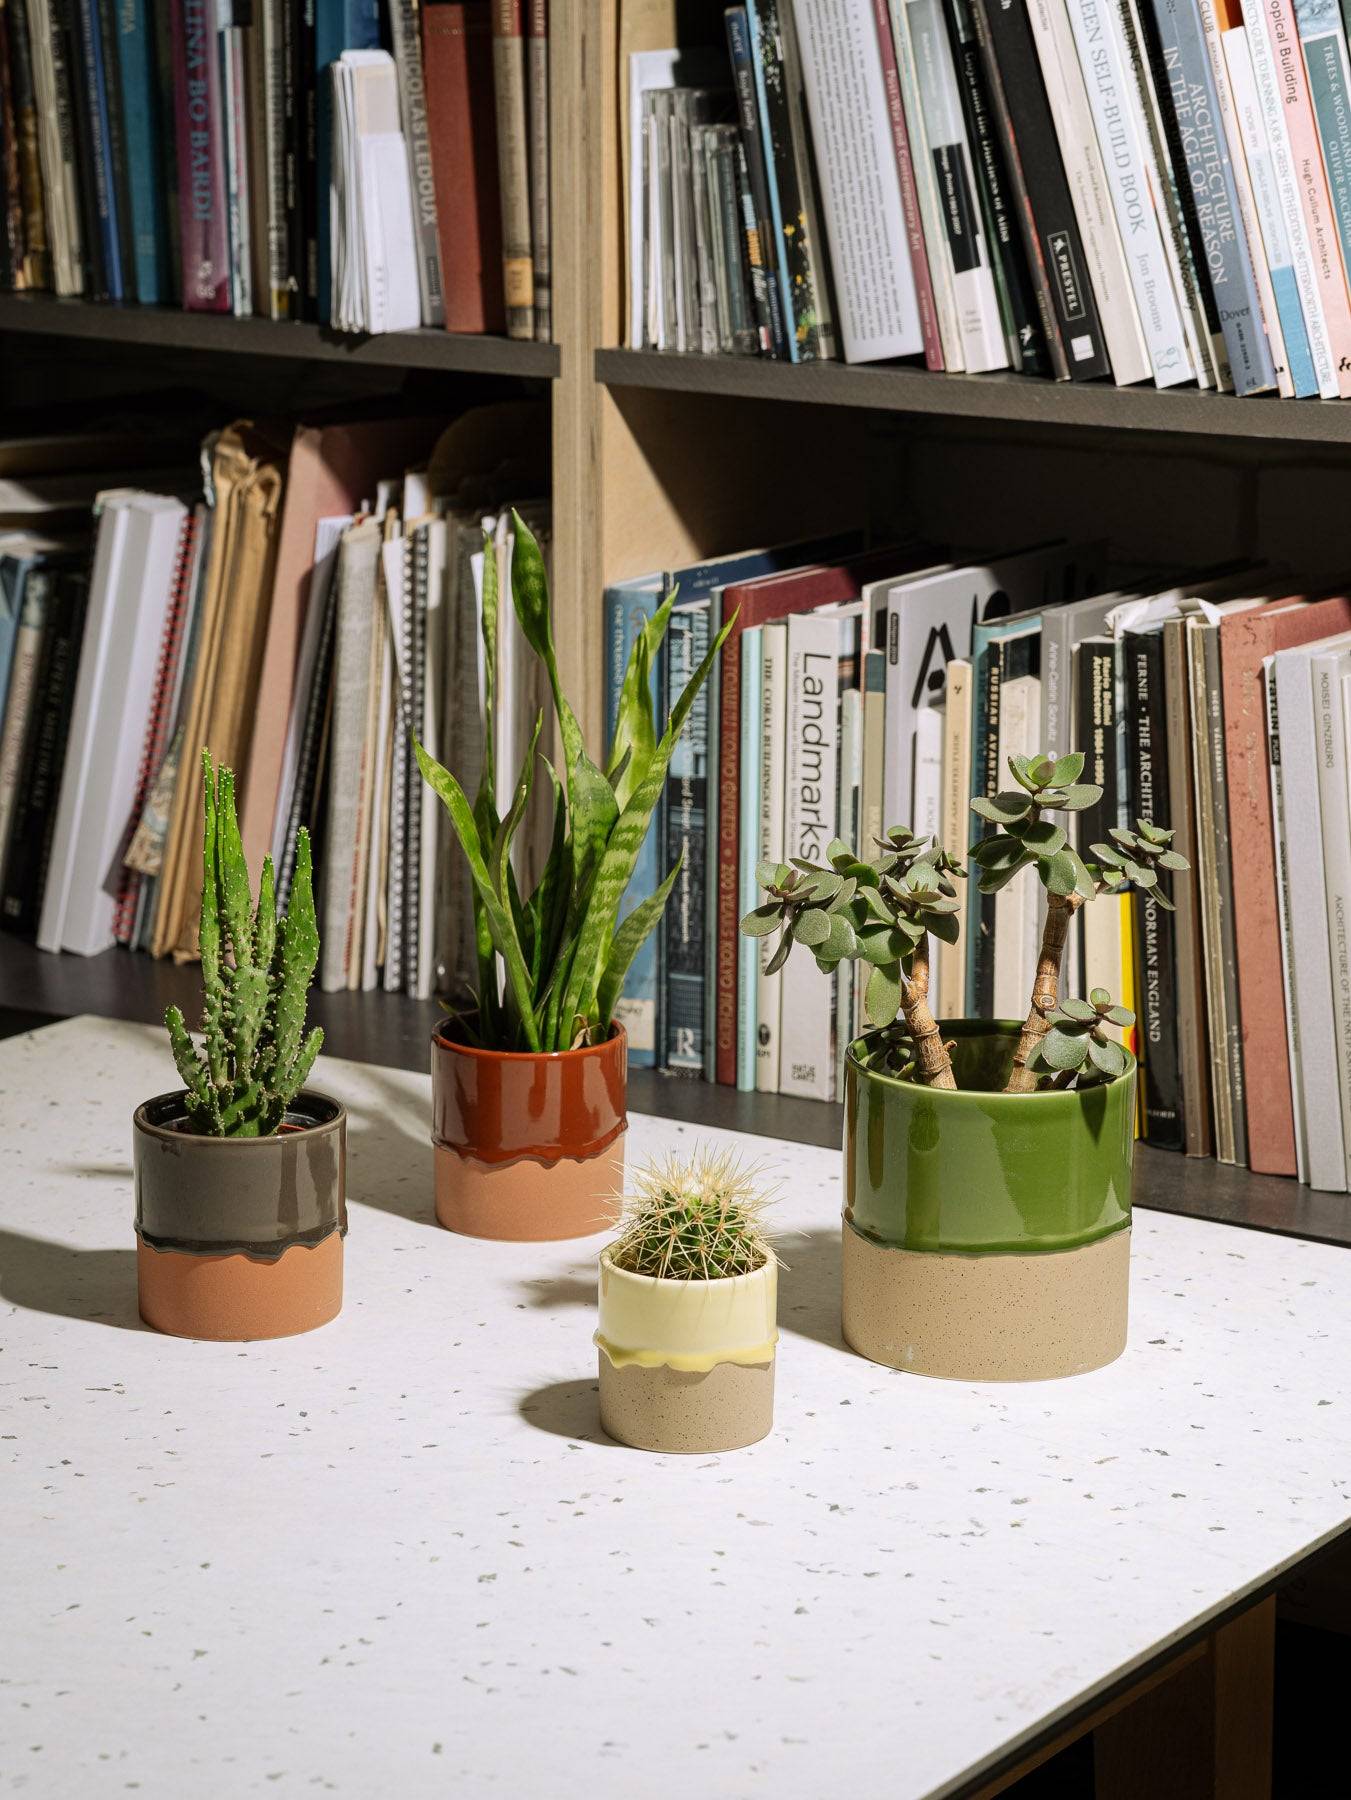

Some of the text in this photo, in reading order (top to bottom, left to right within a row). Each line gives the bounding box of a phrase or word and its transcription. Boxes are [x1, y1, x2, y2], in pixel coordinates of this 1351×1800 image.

[1114, 0, 1143, 72] BUILDING
[1195, 0, 1218, 33] CLUB
[1249, 26, 1266, 56] GUIDE
[1255, 56, 1269, 72] TO
[1268, 0, 1300, 104] opical Building
[187, 79, 208, 122] BO
[400, 37, 429, 135] NICOLAS
[1257, 70, 1279, 117] RUNNING
[1322, 43, 1351, 169] TREES & WOODLAND
[892, 124, 907, 146] and
[1089, 47, 1132, 169] SELF-BUILD
[1118, 173, 1147, 236] BOOK
[1328, 138, 1345, 183] OLIVER
[188, 129, 213, 221] BARDI
[410, 138, 440, 225] LEDOUX
[1160, 45, 1229, 285] IN THE AGE OF REASON
[1184, 80, 1238, 244] ARCHITECTURE
[1273, 147, 1291, 178] GREEN
[893, 148, 921, 230] Contemporary
[1286, 207, 1305, 247] EDITION
[1299, 158, 1332, 280] Hugh Cullum Architects
[1054, 253, 1081, 311] PRESTEL
[1134, 251, 1167, 333] Jon Broome
[1169, 223, 1199, 313] Tom Woolley
[1295, 249, 1319, 318] BUTTERWORTH
[1218, 301, 1251, 323] Dover
[1309, 317, 1333, 385] ARCHITECTURE
[763, 657, 772, 682] THE
[792, 652, 800, 666] The
[792, 669, 800, 701] Modern
[1136, 653, 1148, 701] FERNIE
[763, 687, 772, 729] CORAL
[988, 666, 999, 725] RUSSIAN
[1046, 640, 1059, 741] Anne-Catrin Schultz
[1090, 655, 1103, 725] Architecture
[1101, 655, 1113, 726] Mario Bellini
[791, 704, 799, 732] House
[1137, 715, 1151, 747] THE
[1319, 671, 1334, 768] MOISEI GINZBURG
[762, 734, 771, 801] BUILDINGS
[790, 743, 798, 781] Denmark
[799, 652, 831, 860] Landmarks
[761, 802, 770, 819] OF
[790, 787, 798, 819] Michael
[720, 862, 735, 890] 200
[719, 893, 735, 937] YEARS
[1334, 895, 1347, 976] ARCHITECTURE
[1144, 896, 1160, 1042] NORMAN ENGLAND
[1340, 978, 1349, 992] OF
[1342, 996, 1350, 1020] THE
[677, 1027, 696, 1057] R
